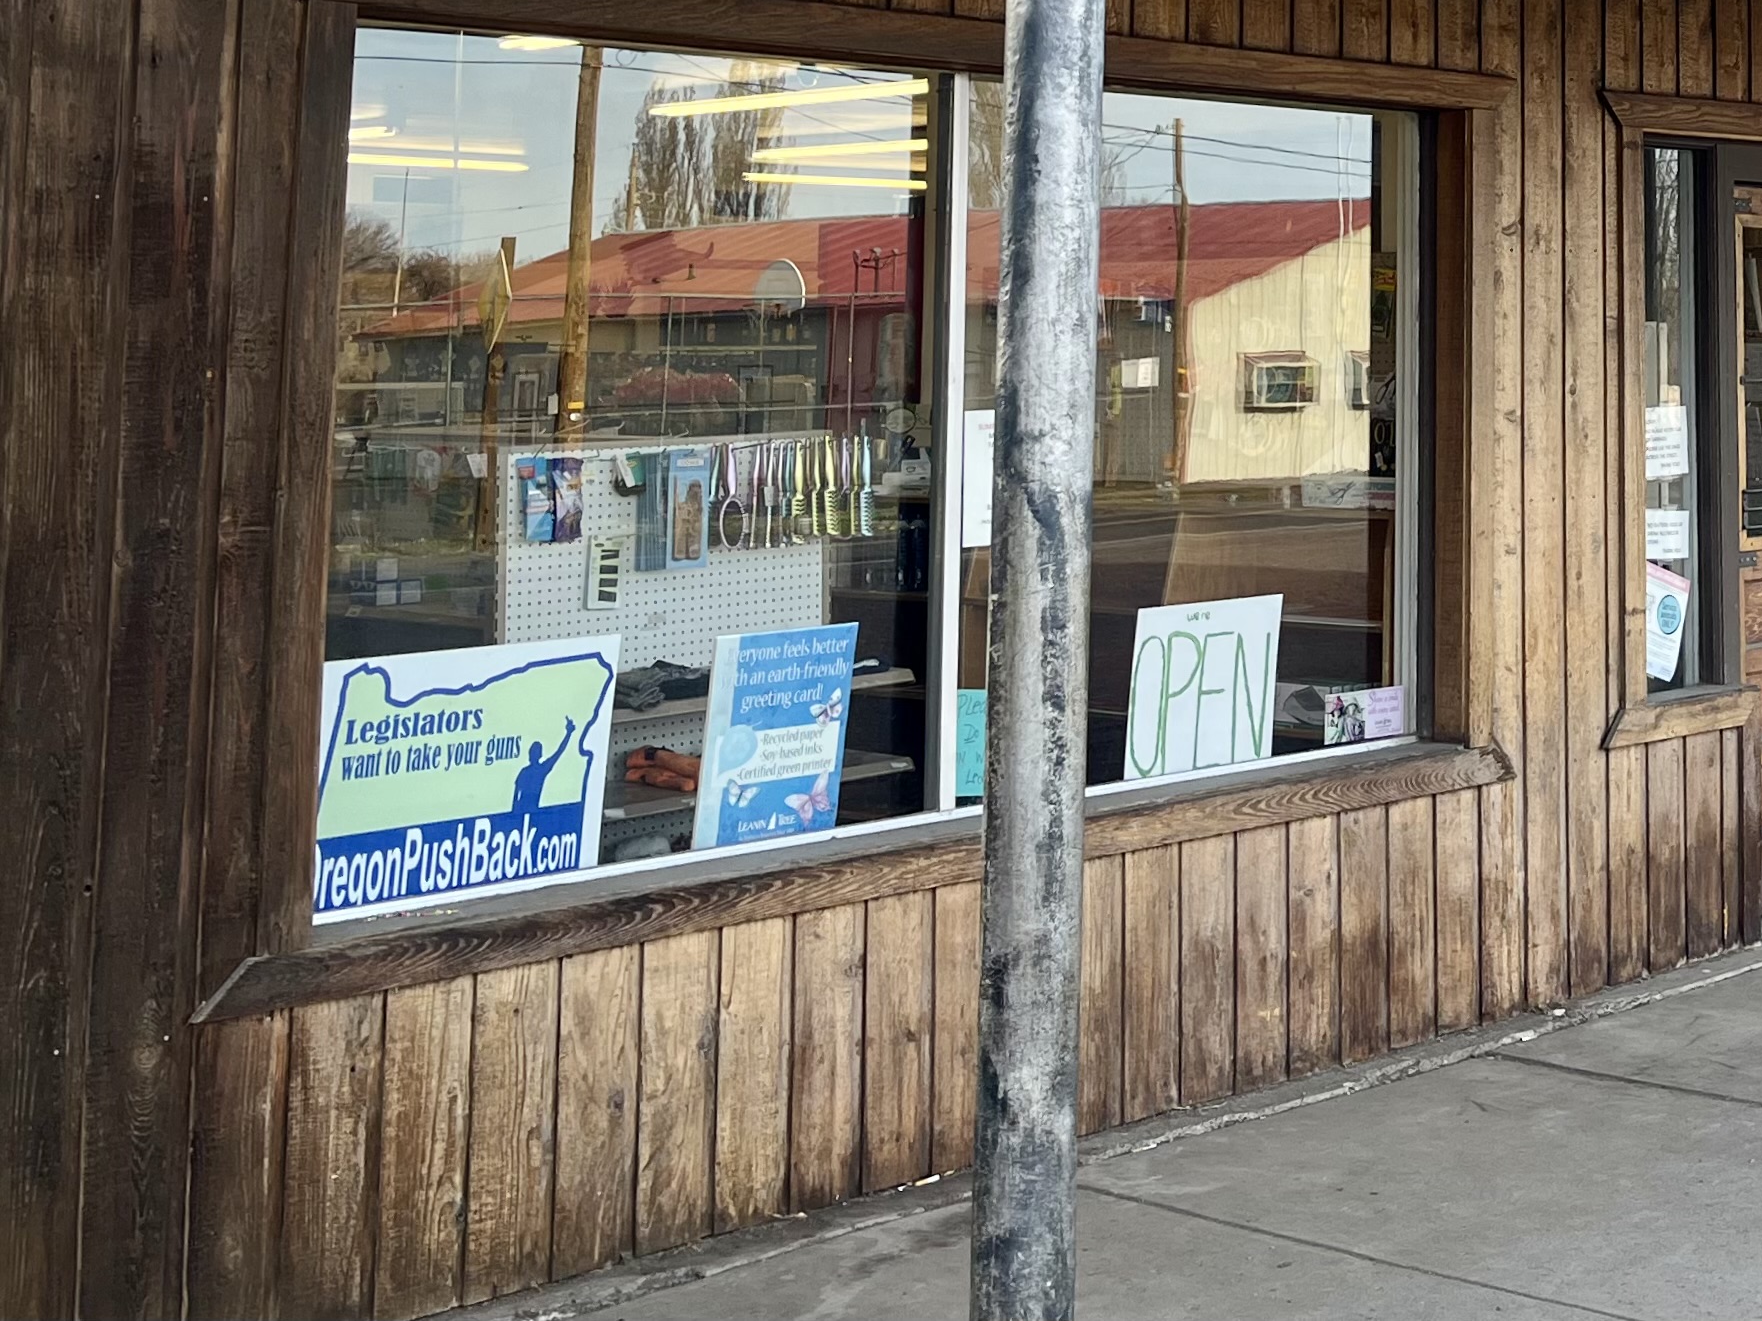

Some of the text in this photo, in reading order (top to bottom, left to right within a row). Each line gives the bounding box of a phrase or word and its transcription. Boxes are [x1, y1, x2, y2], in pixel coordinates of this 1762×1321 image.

[783, 639, 810, 658] feels
[812, 637, 849, 654] better
[750, 671, 767, 686] an
[768, 657, 850, 682] earth-friendly
[740, 683, 824, 714] greeting card!
[1130, 631, 1271, 778] OPEN
[344, 708, 483, 746] Legislators
[800, 729, 824, 743] paper
[342, 734, 521, 782] want to take your guns
[805, 742, 822, 756] inks
[777, 762, 800, 777] green
[802, 758, 832, 775] printer
